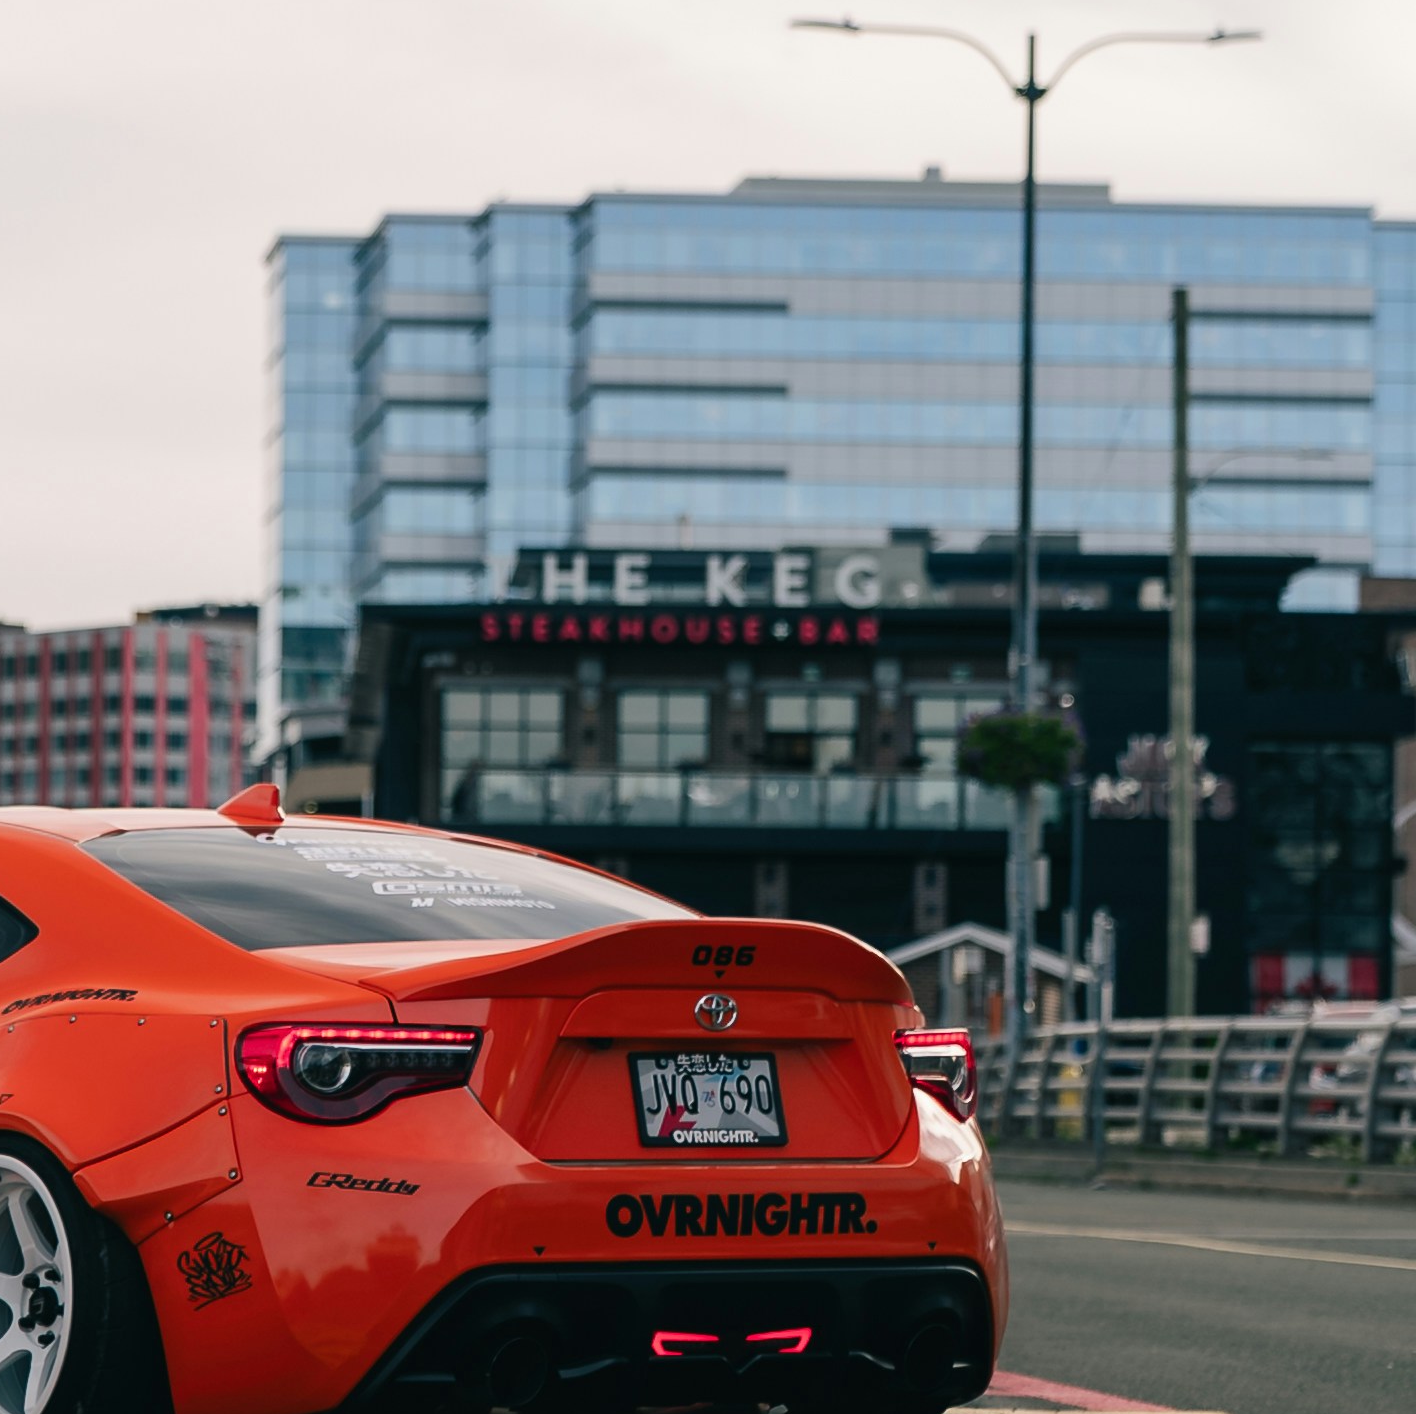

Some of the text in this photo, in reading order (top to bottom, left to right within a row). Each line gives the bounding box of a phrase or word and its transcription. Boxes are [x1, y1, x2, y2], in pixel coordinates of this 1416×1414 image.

[487, 553, 882, 609] THE KEG
[480, 613, 763, 644] STEAKHOUSE
[798, 615, 881, 646] BAR
[691, 944, 756, 966] 086
[676, 1053, 735, 1074] 失恋した
[646, 1073, 774, 1116] JVQ 690
[672, 1128, 760, 1144] OVRNIGHTR.
[305, 1171, 422, 1196] GReddy
[605, 1192, 879, 1238] OVRNIGHTR.
